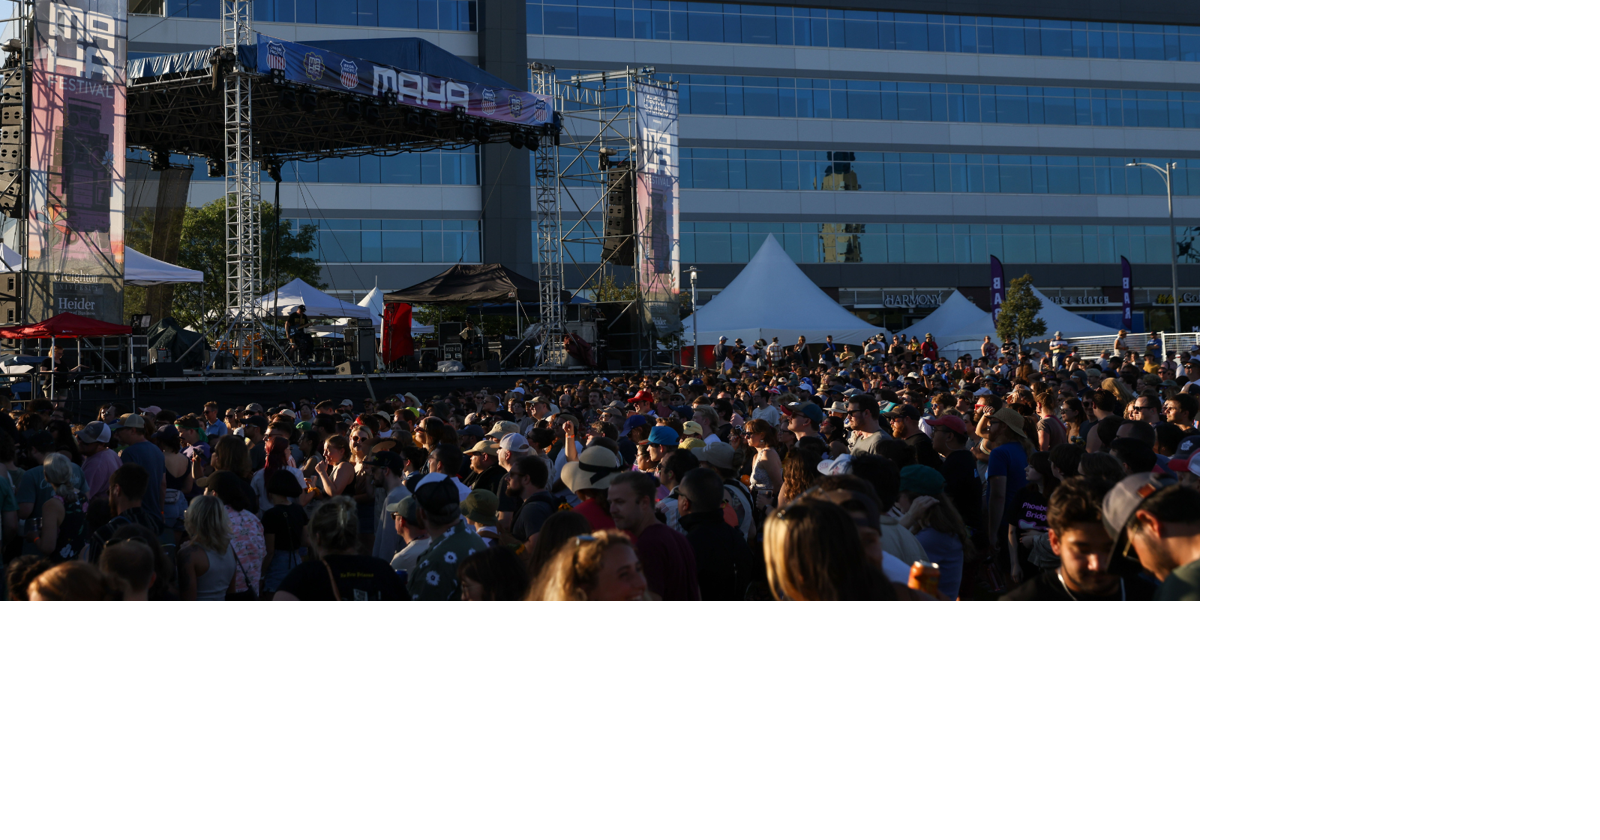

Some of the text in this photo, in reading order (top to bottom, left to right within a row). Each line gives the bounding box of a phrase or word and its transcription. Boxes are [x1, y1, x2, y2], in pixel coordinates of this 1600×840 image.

[47, 75, 114, 99] FESTIVAL
[373, 66, 469, 113] MAHA
[644, 174, 671, 187] FESTIVAL
[53, 268, 98, 284] Creighton
[58, 297, 96, 310] Heider
[884, 292, 944, 308] HARMONY
[1077, 295, 1109, 304] SCOTCH
